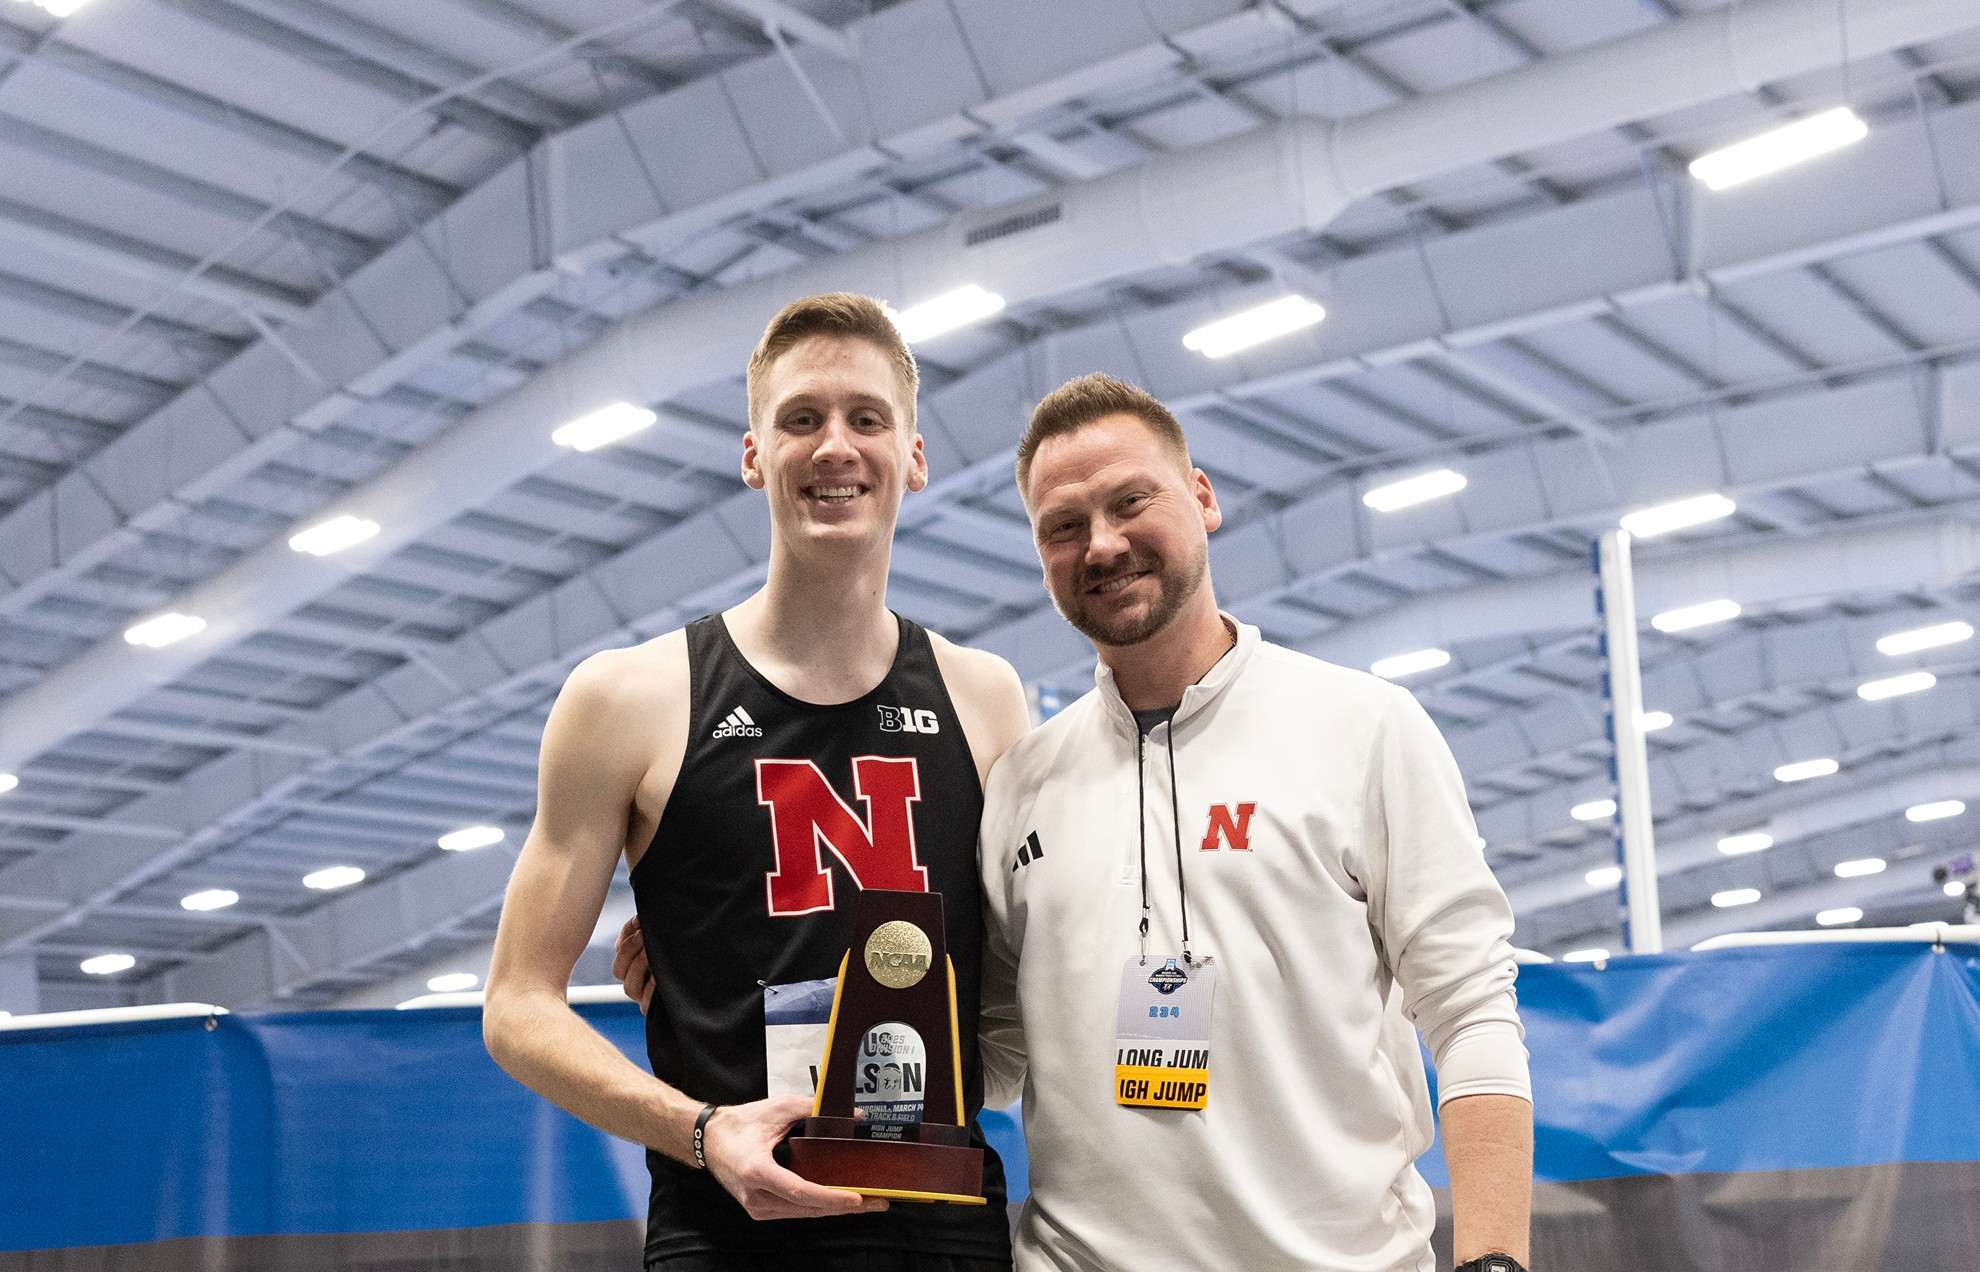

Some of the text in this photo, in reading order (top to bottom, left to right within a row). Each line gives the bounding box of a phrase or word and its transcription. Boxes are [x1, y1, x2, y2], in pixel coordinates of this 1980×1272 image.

[712, 724, 763, 739] adidas
[1199, 801, 1258, 853] N
[753, 754, 931, 918] N
[868, 951, 928, 971] NCAA
[1148, 1005, 1180, 1019] 234
[1117, 1048, 1164, 1068] LONG
[1152, 1081, 1208, 1103] JUMP
[892, 1104, 917, 1112] MARCH
[870, 1112, 892, 1121] TRACK
[897, 1114, 916, 1122] FIELD
[870, 1124, 904, 1133] HIGH JUMP
[871, 1131, 903, 1140] CHAMPION
